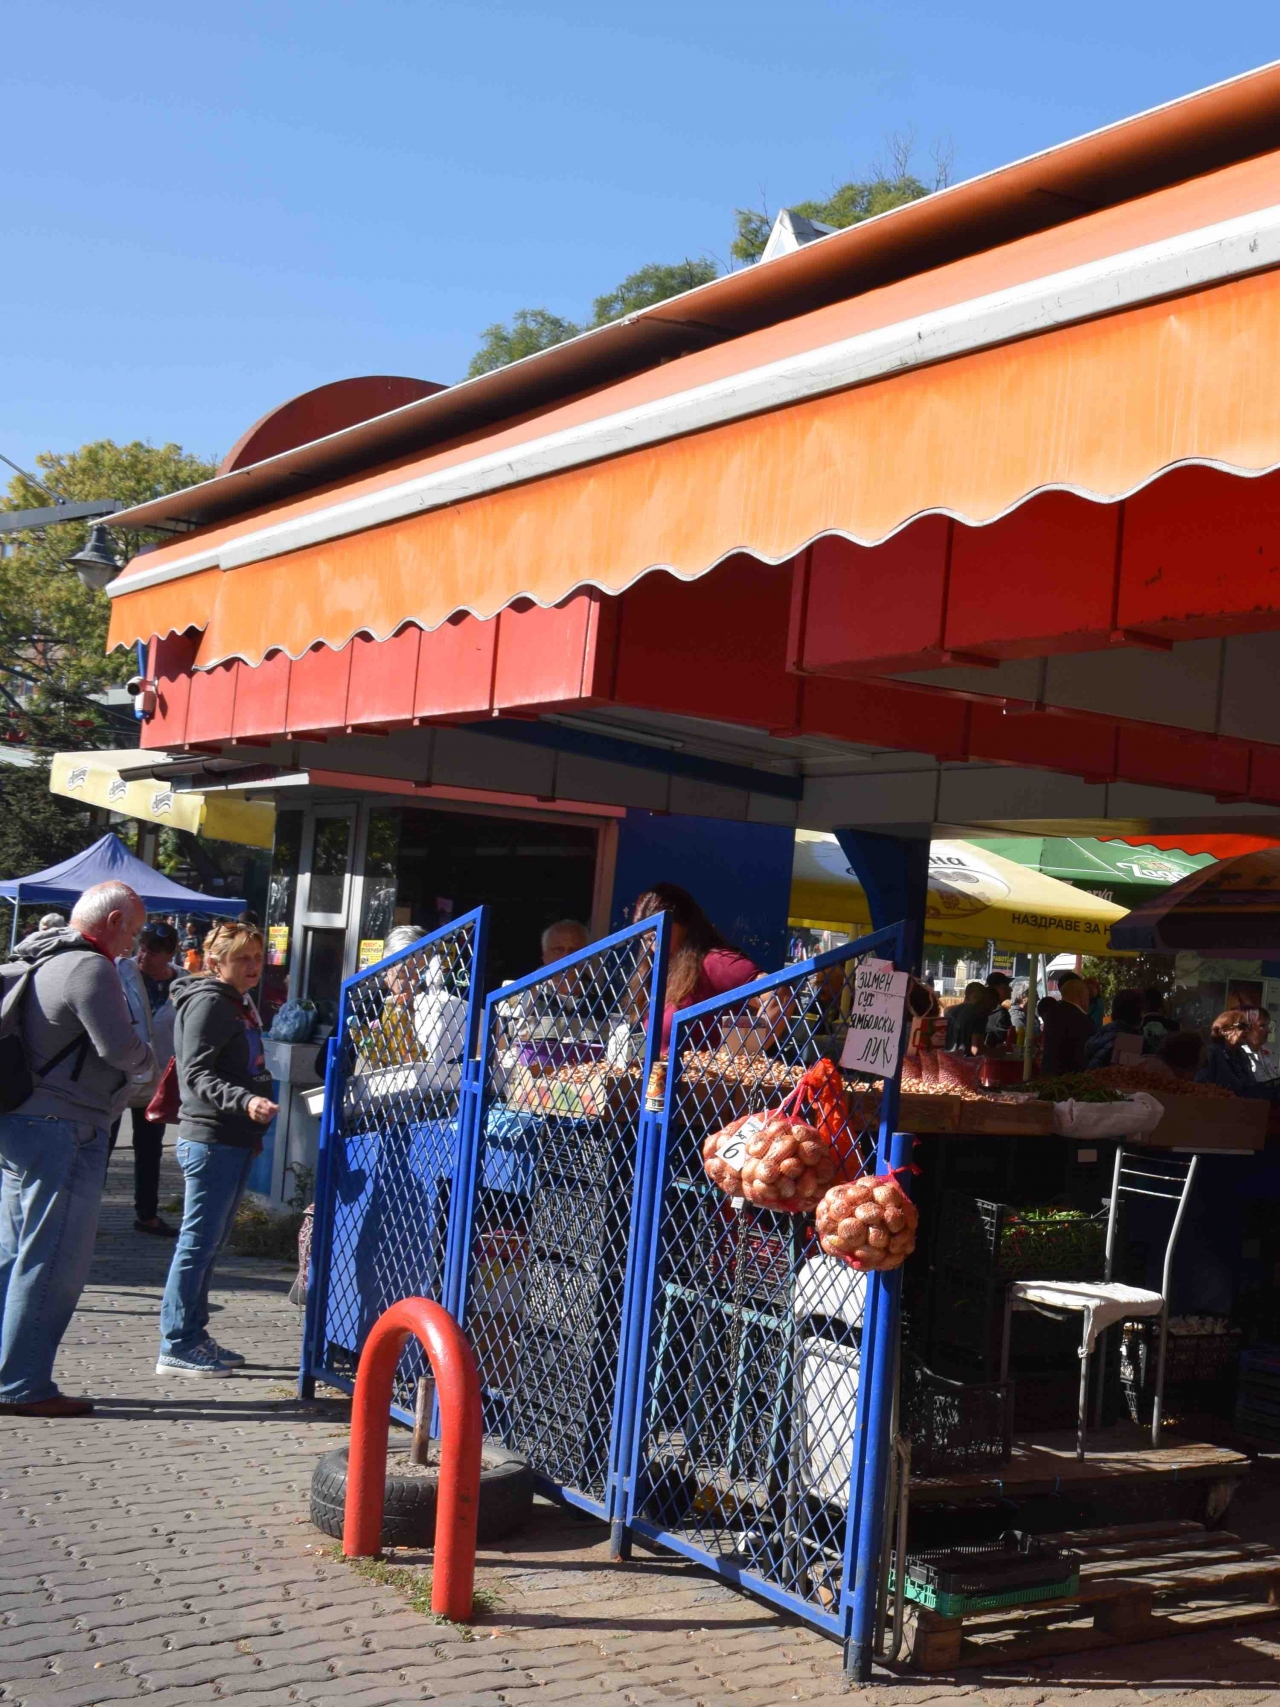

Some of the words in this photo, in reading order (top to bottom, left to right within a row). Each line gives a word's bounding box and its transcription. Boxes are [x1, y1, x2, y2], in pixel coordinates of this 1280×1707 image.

[1012, 913, 1081, 932] НАЗДРАВЕ
[1084, 922, 1100, 934] ЗА
[723, 1141, 746, 1159] 6
